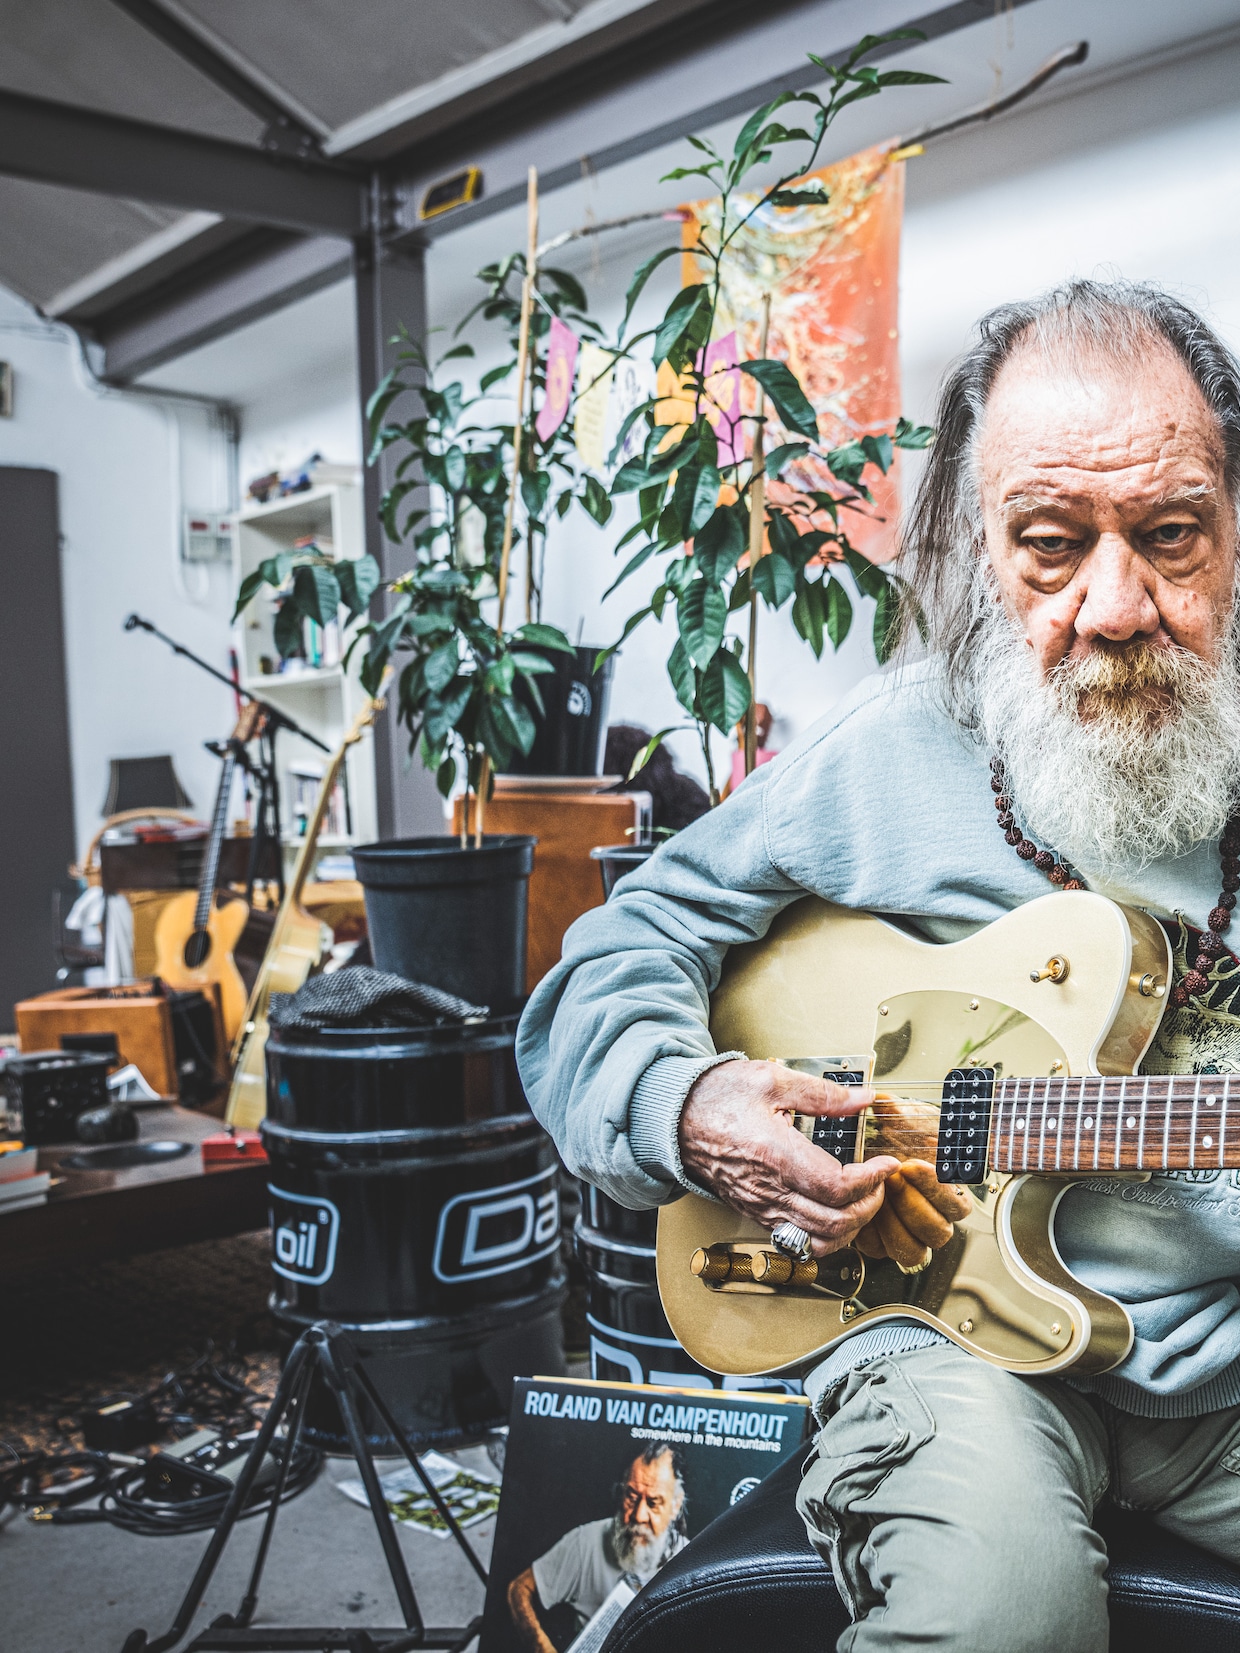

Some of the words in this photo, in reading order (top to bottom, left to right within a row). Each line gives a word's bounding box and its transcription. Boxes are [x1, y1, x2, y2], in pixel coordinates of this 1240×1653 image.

[1121, 1182, 1223, 1212] Independent
[524, 1390, 602, 1422] ROLAND
[606, 1398, 646, 1426] VAN
[648, 1402, 789, 1441] CAMPENHOUT
[630, 1426, 692, 1444] somewhere
[693, 1431, 703, 1445] in
[705, 1432, 723, 1447] the
[724, 1436, 782, 1453] mountains
